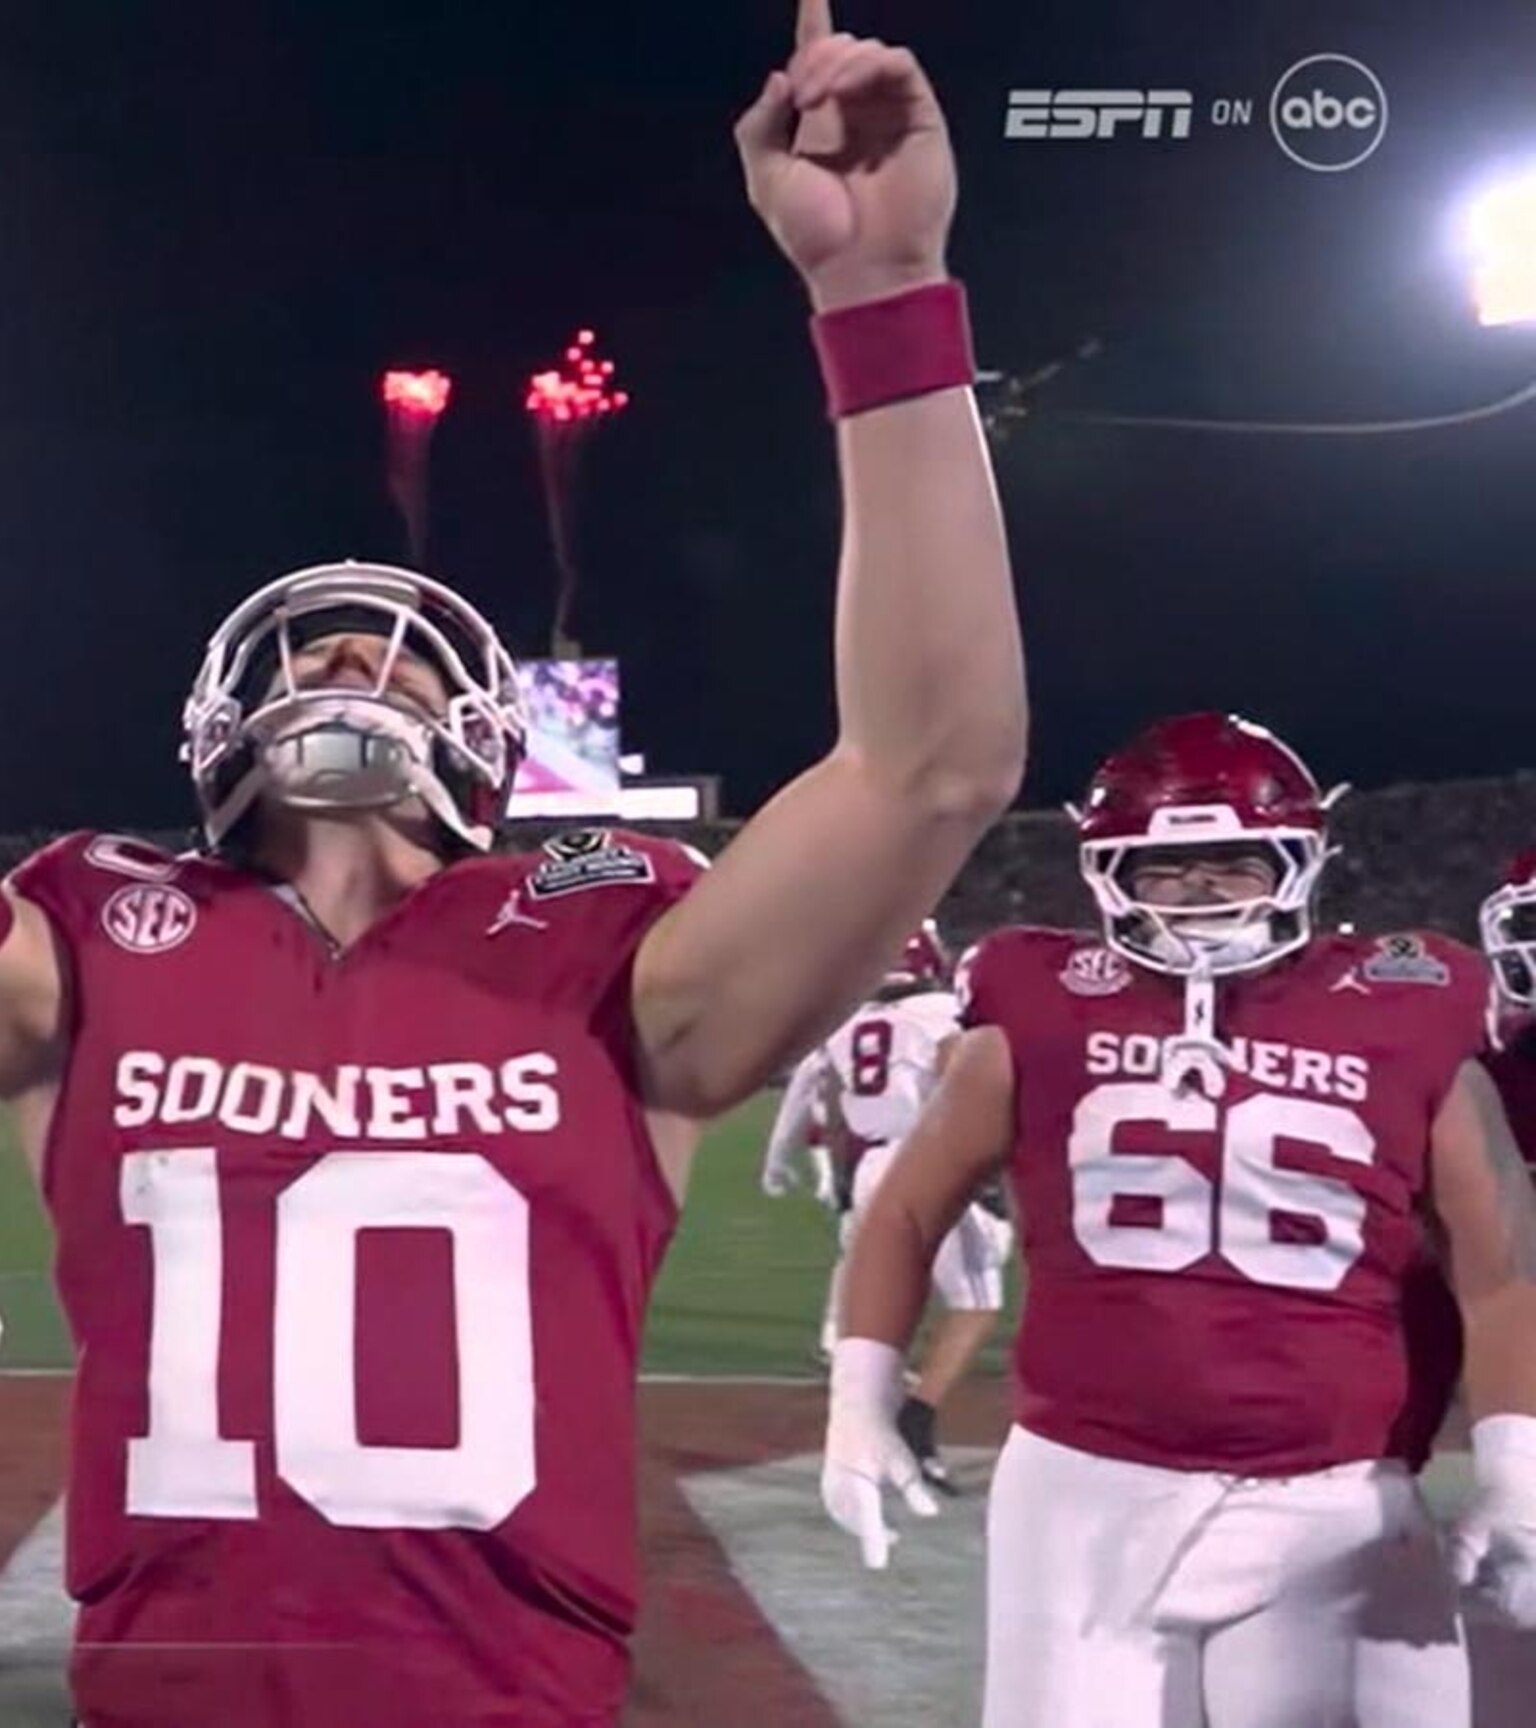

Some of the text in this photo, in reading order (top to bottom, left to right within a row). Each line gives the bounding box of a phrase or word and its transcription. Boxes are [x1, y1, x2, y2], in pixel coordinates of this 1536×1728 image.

[112, 888, 188, 946] SEC
[114, 1051, 560, 1139] SOONERS
[852, 1019, 893, 1098] 8
[1085, 1031, 1370, 1102] SONERS
[1068, 1081, 1376, 1292] 66
[119, 1146, 537, 1532] 10
